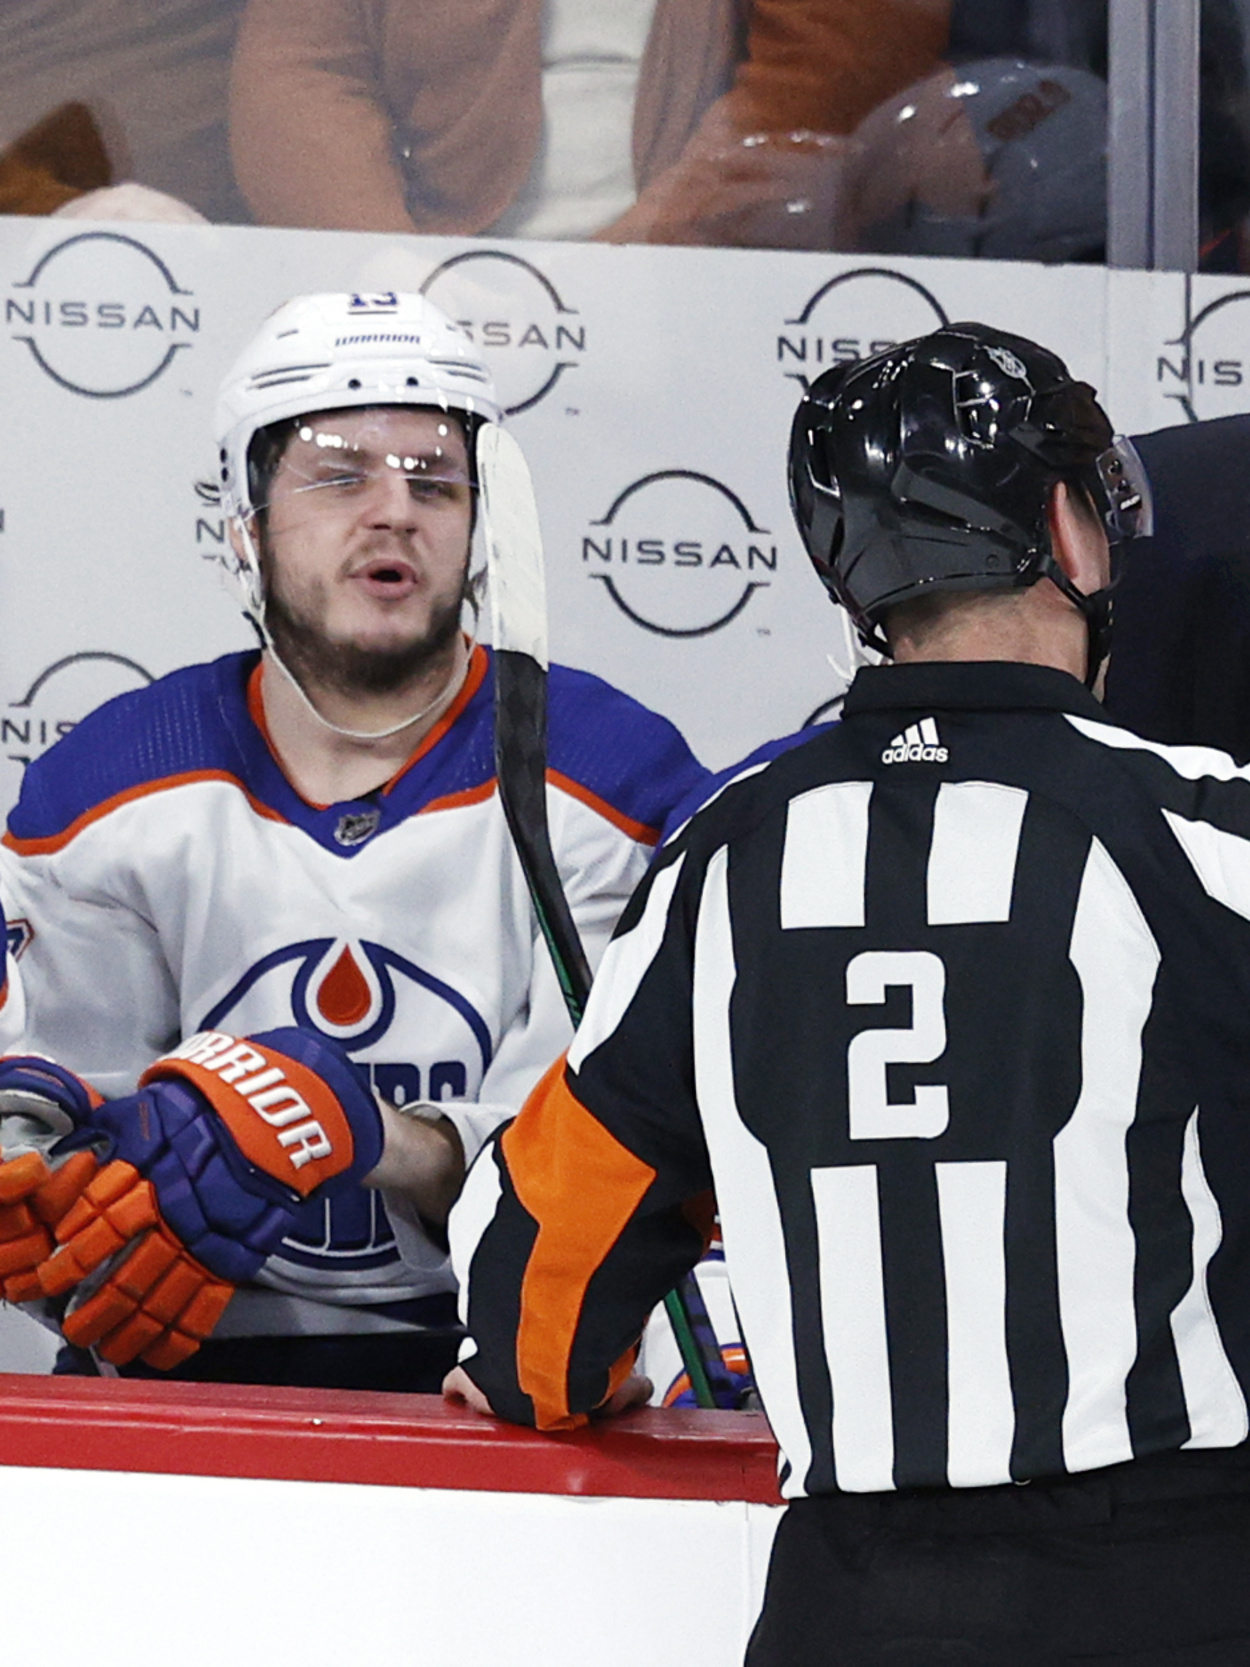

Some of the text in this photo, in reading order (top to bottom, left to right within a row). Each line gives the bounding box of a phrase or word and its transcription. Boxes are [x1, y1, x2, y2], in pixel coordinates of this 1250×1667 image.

[6, 299, 200, 332] NISSAN
[456, 320, 585, 351] SAN
[582, 537, 777, 571] NISSAN
[881, 742, 949, 764] adidas
[846, 950, 950, 1140] 2
[166, 1031, 333, 1170] RRIOR
